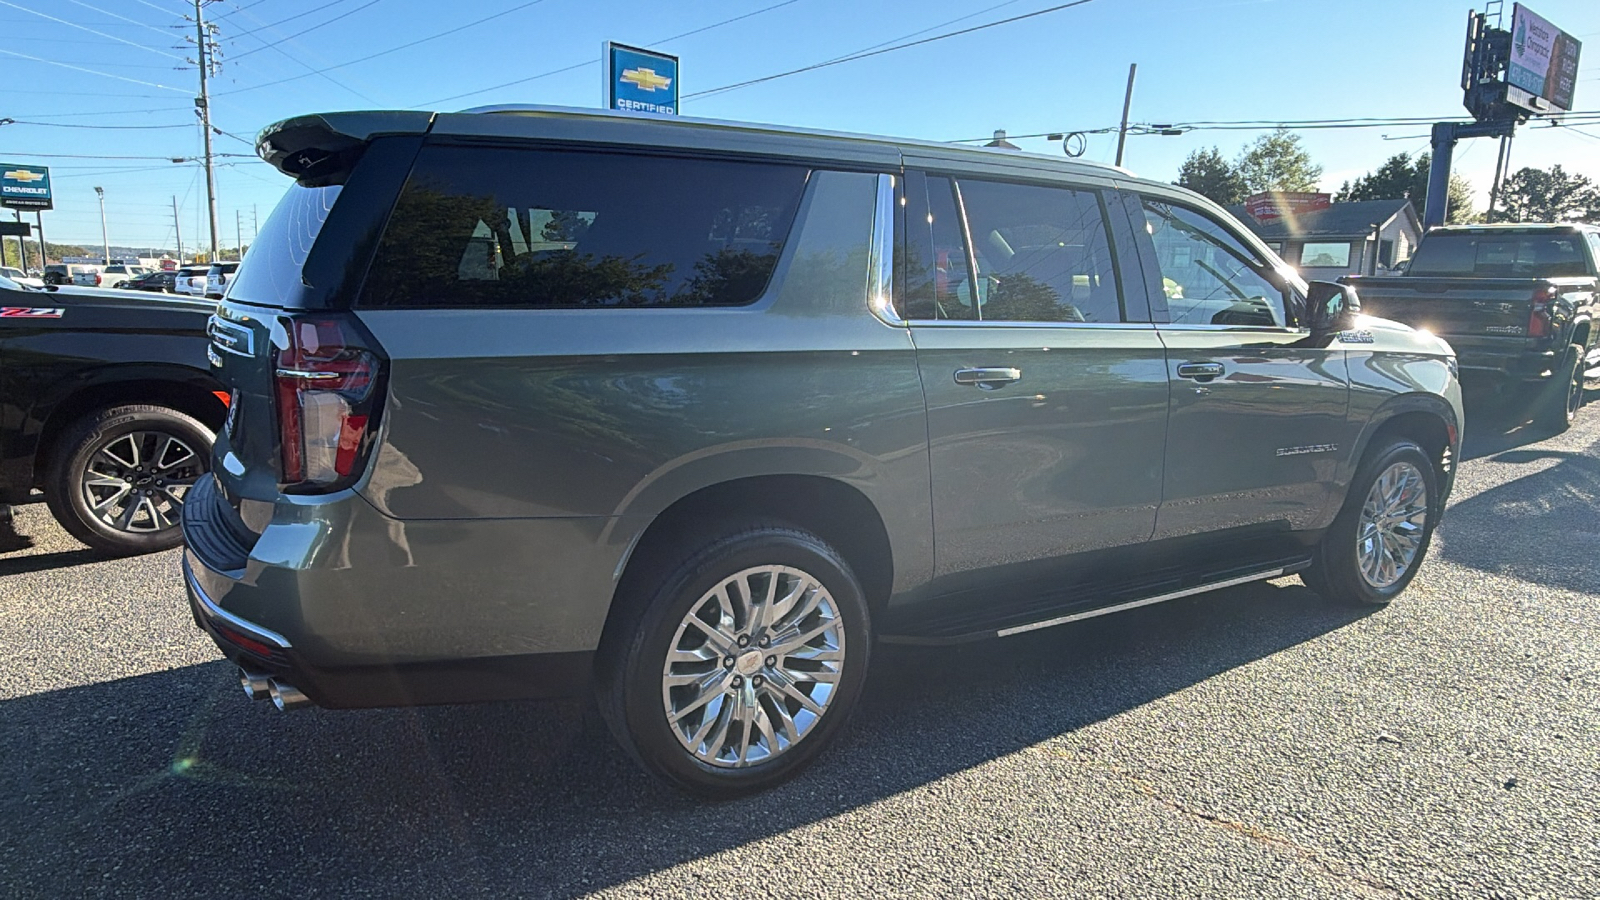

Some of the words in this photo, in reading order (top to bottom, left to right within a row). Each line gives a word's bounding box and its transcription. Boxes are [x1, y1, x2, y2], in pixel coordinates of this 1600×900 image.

[1526, 36, 1550, 59] Chiropractic
[617, 98, 674, 114] CERTIFIED
[2, 186, 48, 195] CHEVROLET
